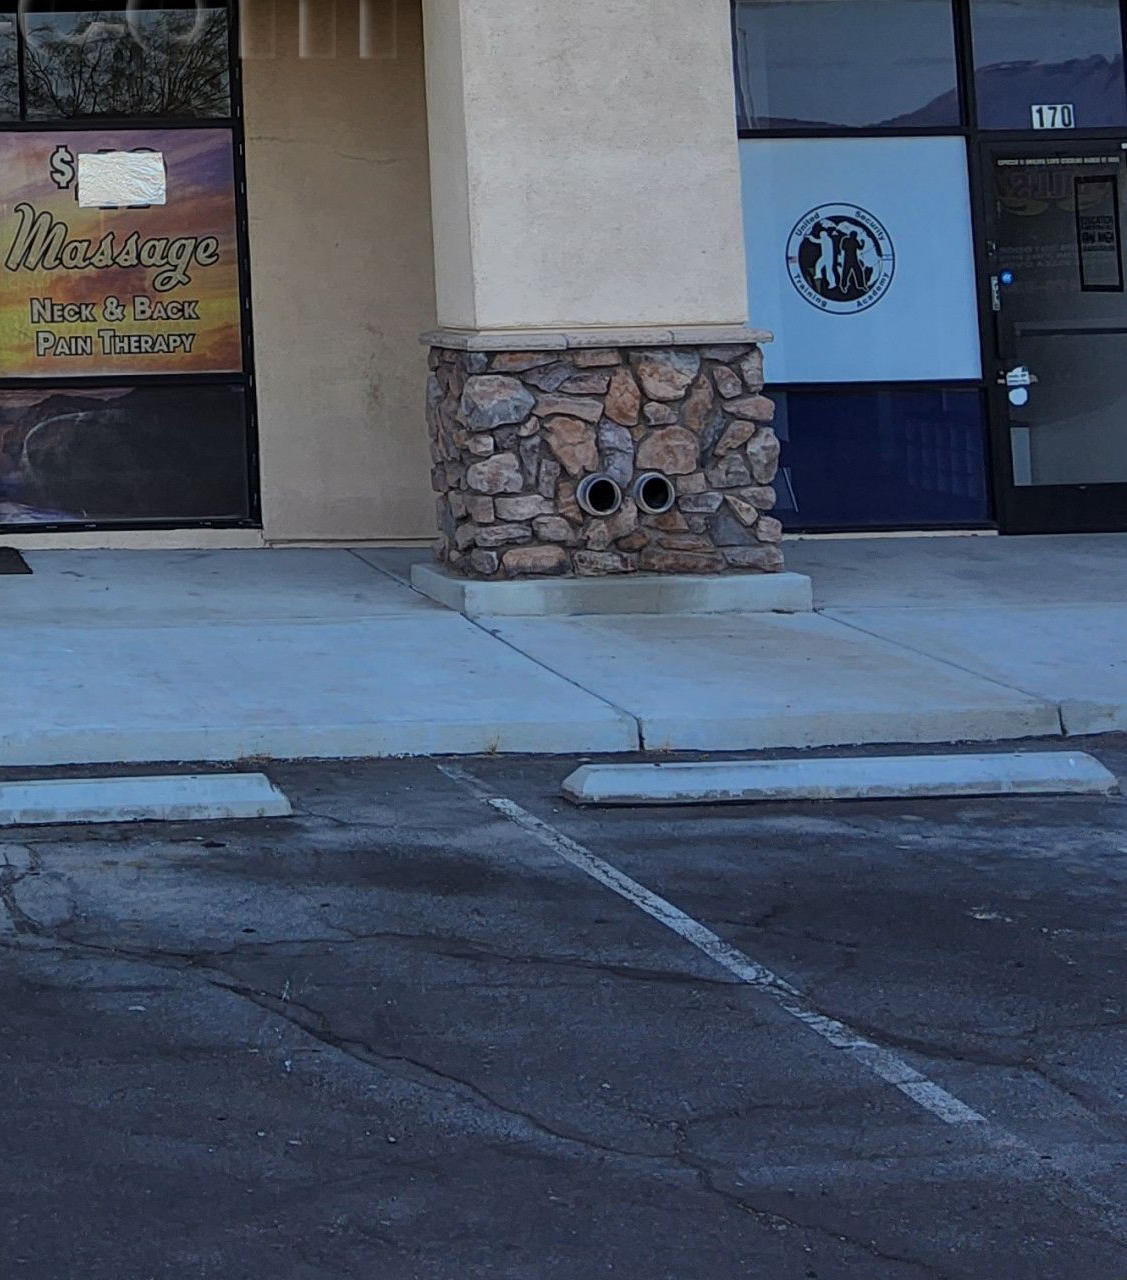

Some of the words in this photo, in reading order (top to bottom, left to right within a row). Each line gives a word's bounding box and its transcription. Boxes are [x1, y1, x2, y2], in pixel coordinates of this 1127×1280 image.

[1035, 105, 1072, 128] 170
[795, 212, 820, 237] United
[854, 210, 886, 241] Security
[5, 204, 220, 291] Massage
[793, 273, 828, 308] Training
[856, 272, 889, 308] Academy
[30, 297, 97, 323] NECK
[103, 295, 126, 321] &
[133, 295, 200, 320] BACK
[36, 331, 92, 356] PAIN
[98, 328, 196, 355] THERAPY
